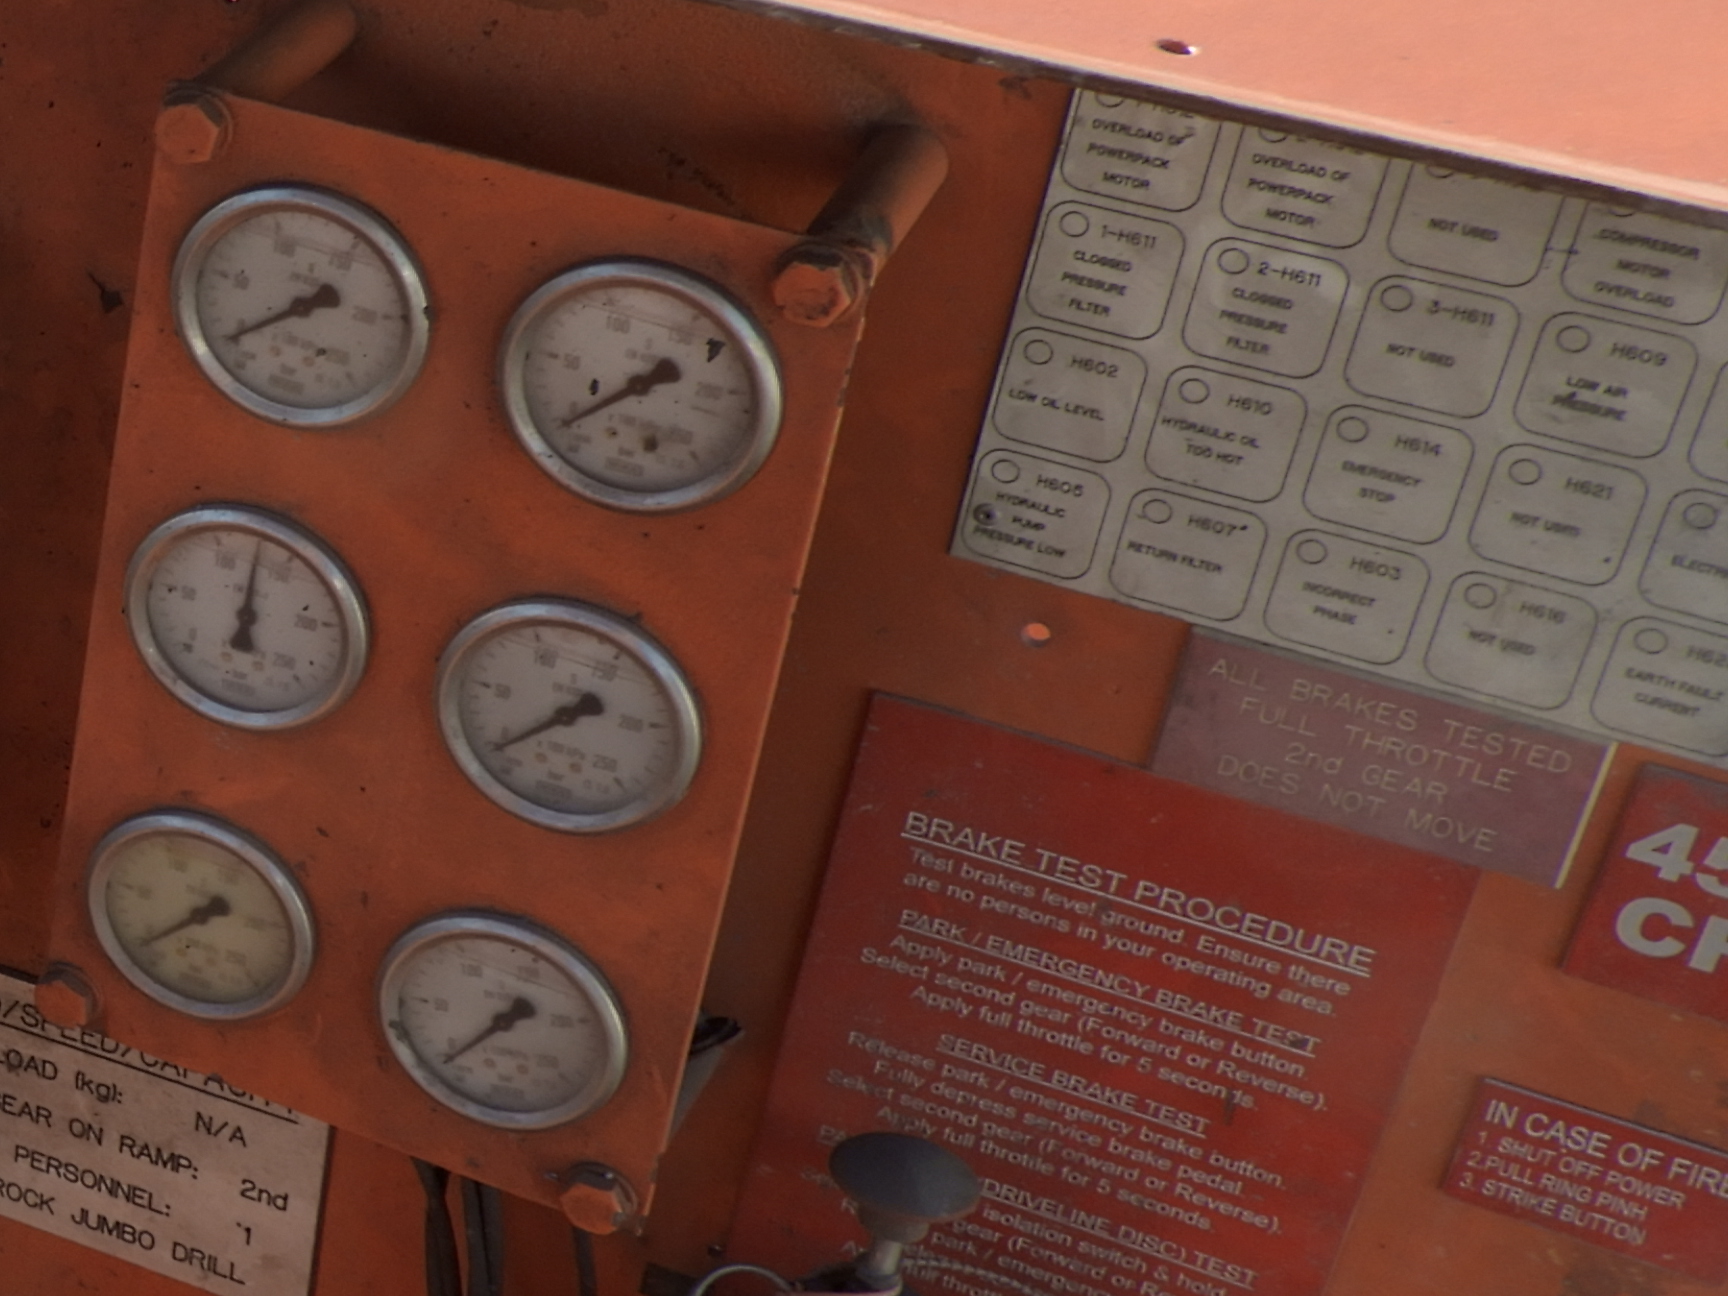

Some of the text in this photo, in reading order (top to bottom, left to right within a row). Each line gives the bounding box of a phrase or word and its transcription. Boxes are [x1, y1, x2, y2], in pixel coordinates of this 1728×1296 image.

[1101, 225, 1156, 248] 1-H611
[1257, 262, 1320, 288] 2-H611
[1070, 355, 1119, 378] H602
[1610, 342, 1668, 366] H609
[1064, 402, 1105, 421] LEVEL
[1394, 434, 1442, 457] H614
[1350, 556, 1402, 581] H603
[619, 713, 643, 732] 200
[1208, 658, 1574, 774] ALL BRAKES TESTED
[1239, 695, 1519, 793] FULL THROTTLE
[593, 754, 617, 772] 250
[1284, 742, 1448, 803] 2nd GEAR
[1217, 753, 1499, 852] DOES NOT MOVE
[905, 811, 1377, 973] BRAKE TEST PROCEDURE
[910, 846, 954, 873] Test
[961, 862, 1036, 898] brakes
[1042, 887, 1096, 917] level
[1196, 935, 1282, 974] Ensure
[1288, 964, 1351, 995] there
[900, 909, 968, 940] PARK
[986, 935, 1150, 998] EMERGENCY
[1155, 989, 1244, 1030] BRAKE
[904, 872, 941, 893] are
[946, 884, 975, 903] no
[980, 895, 1071, 933] persons
[1076, 924, 1098, 941] in
[1104, 934, 1156, 958] your
[1162, 952, 1272, 999] operating
[860, 947, 929, 980] Select
[934, 972, 1016, 1005] second
[1020, 1000, 1072, 1024] gear
[1077, 1017, 1182, 1060] (Forward
[1186, 1054, 1211, 1069] or
[890, 934, 952, 967] Apply
[956, 957, 1006, 982] park
[1026, 979, 1153, 1030] emergency
[1159, 1018, 1224, 1051] brake
[74, 1070, 123, 1104] (kg):
[195, 1111, 248, 1148] N/A
[1485, 1099, 1518, 1129] IN
[1524, 1112, 1612, 1159] CASE
[1617, 1142, 1664, 1171] OF
[14, 1145, 171, 1218] PERSONNEL:
[68, 1117, 104, 1146] ON
[118, 1134, 200, 1181] RAMP:
[240, 1178, 289, 1212] 2nd
[1485, 1155, 1533, 1185] PULL
[1540, 1173, 1592, 1204] RING
[1498, 1136, 1687, 1210] SHUT OFF POWER
[70, 1207, 156, 1251] JUMBO
[172, 1241, 246, 1285] DRILL
[1482, 1179, 1646, 1246] STRIKE BUTTON
